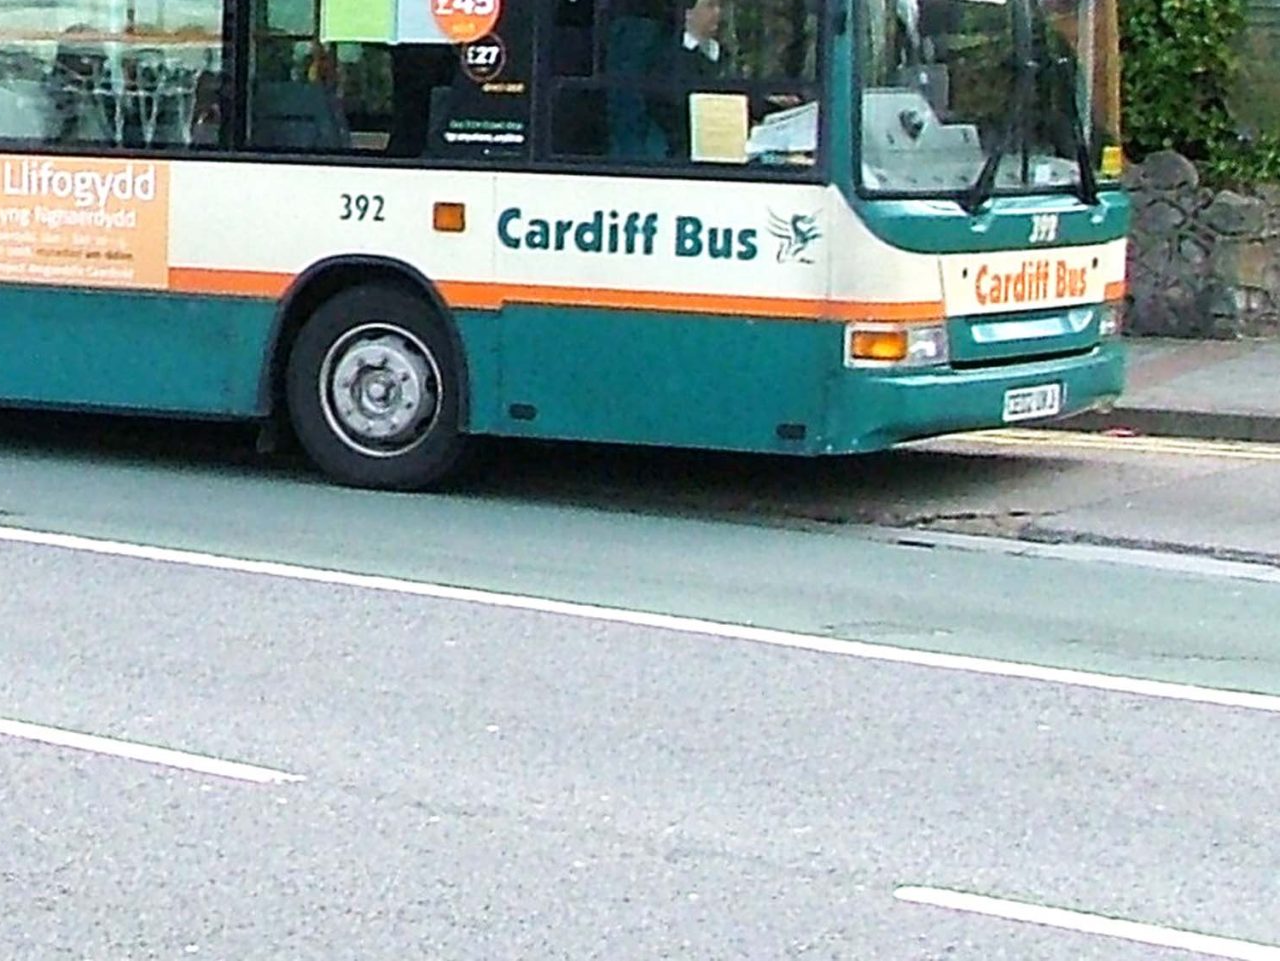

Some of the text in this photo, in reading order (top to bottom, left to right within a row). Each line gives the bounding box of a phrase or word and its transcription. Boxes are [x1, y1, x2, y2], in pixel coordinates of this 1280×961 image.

[467, 45, 500, 65] £27
[3, 160, 156, 208] Llifogydd
[0, 206, 31, 228] yng
[338, 193, 386, 222] 392
[496, 206, 759, 261] Cardiff Bus
[1029, 213, 1059, 243] 392
[974, 259, 1087, 306] Cardiff Bus
